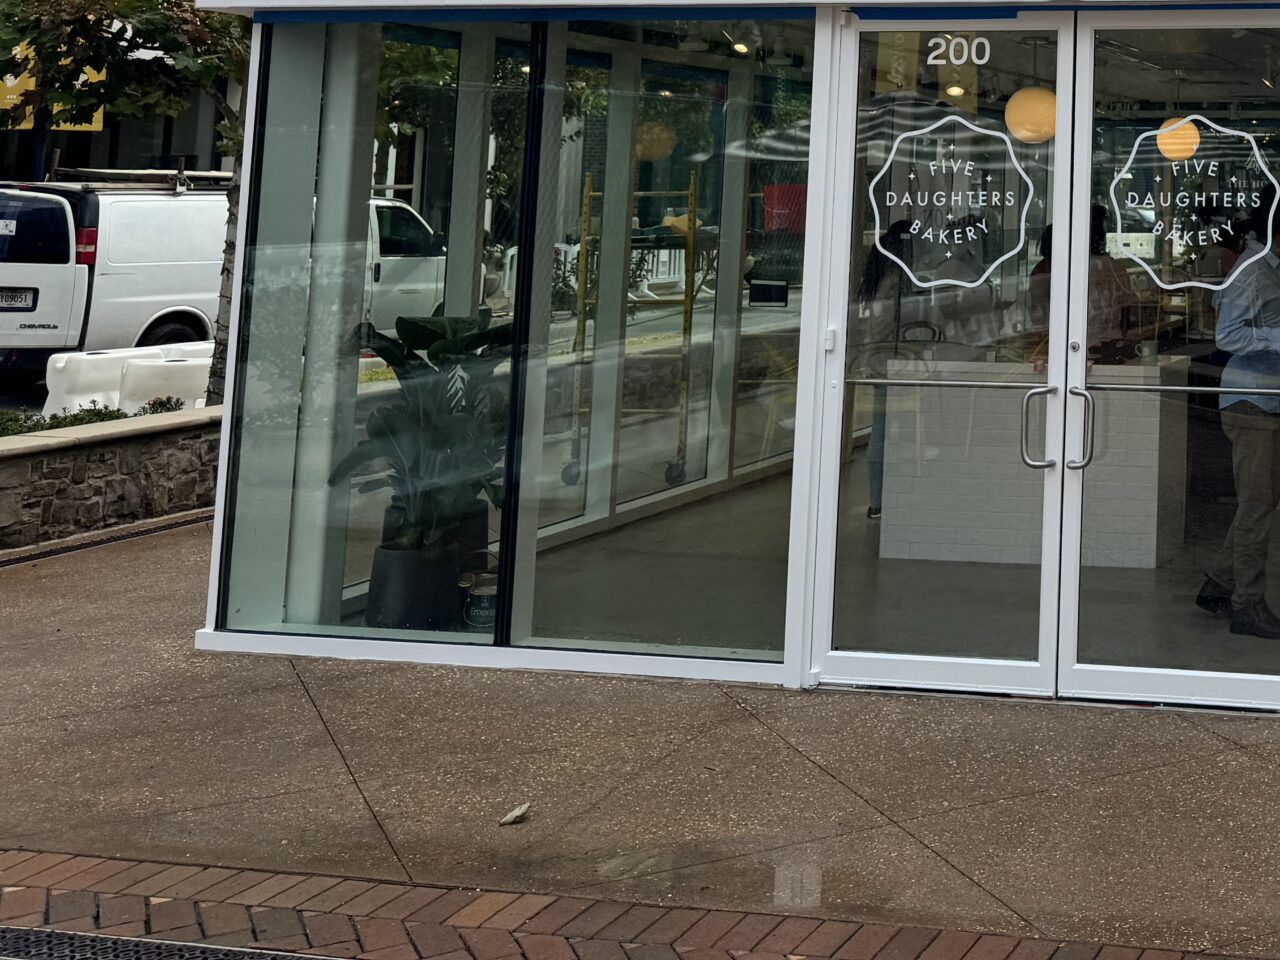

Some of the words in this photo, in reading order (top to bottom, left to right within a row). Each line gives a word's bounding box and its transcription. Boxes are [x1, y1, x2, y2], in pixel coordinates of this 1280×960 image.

[926, 36, 991, 66] 200
[929, 158, 975, 177] FIVE
[1171, 159, 1219, 177] FIVE
[886, 191, 1015, 207] DAUGHTERS
[1127, 192, 1261, 208] DAUGHTERS
[908, 218, 989, 245] BAKERY
[1152, 219, 1235, 247] BAKERY
